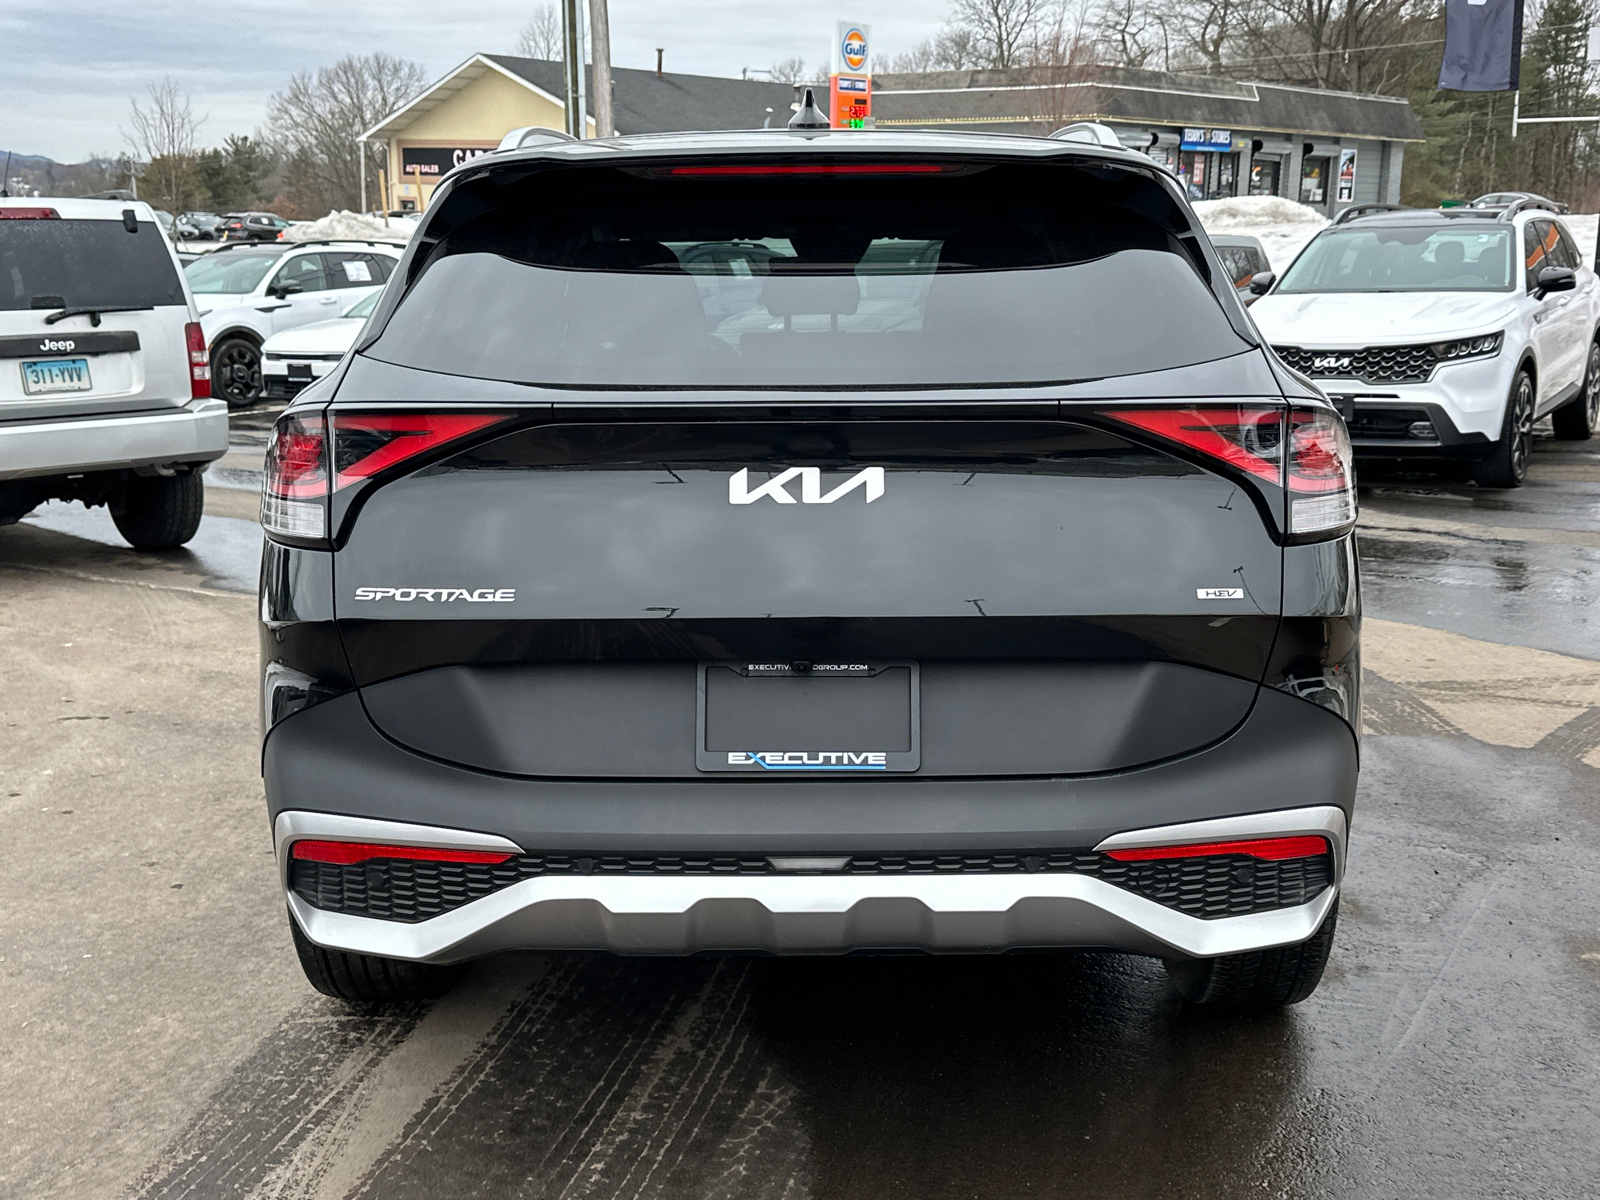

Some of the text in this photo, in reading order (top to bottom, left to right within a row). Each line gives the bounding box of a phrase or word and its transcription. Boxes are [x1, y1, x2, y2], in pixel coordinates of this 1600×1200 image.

[845, 43, 866, 57] Gulf
[421, 164, 439, 173] SALES
[40, 339, 75, 352] Jeep
[729, 467, 885, 504] KIA
[354, 587, 516, 602] SPORTAGE
[1204, 588, 1238, 598] HEV
[727, 752, 886, 765] EXECUTIVE
